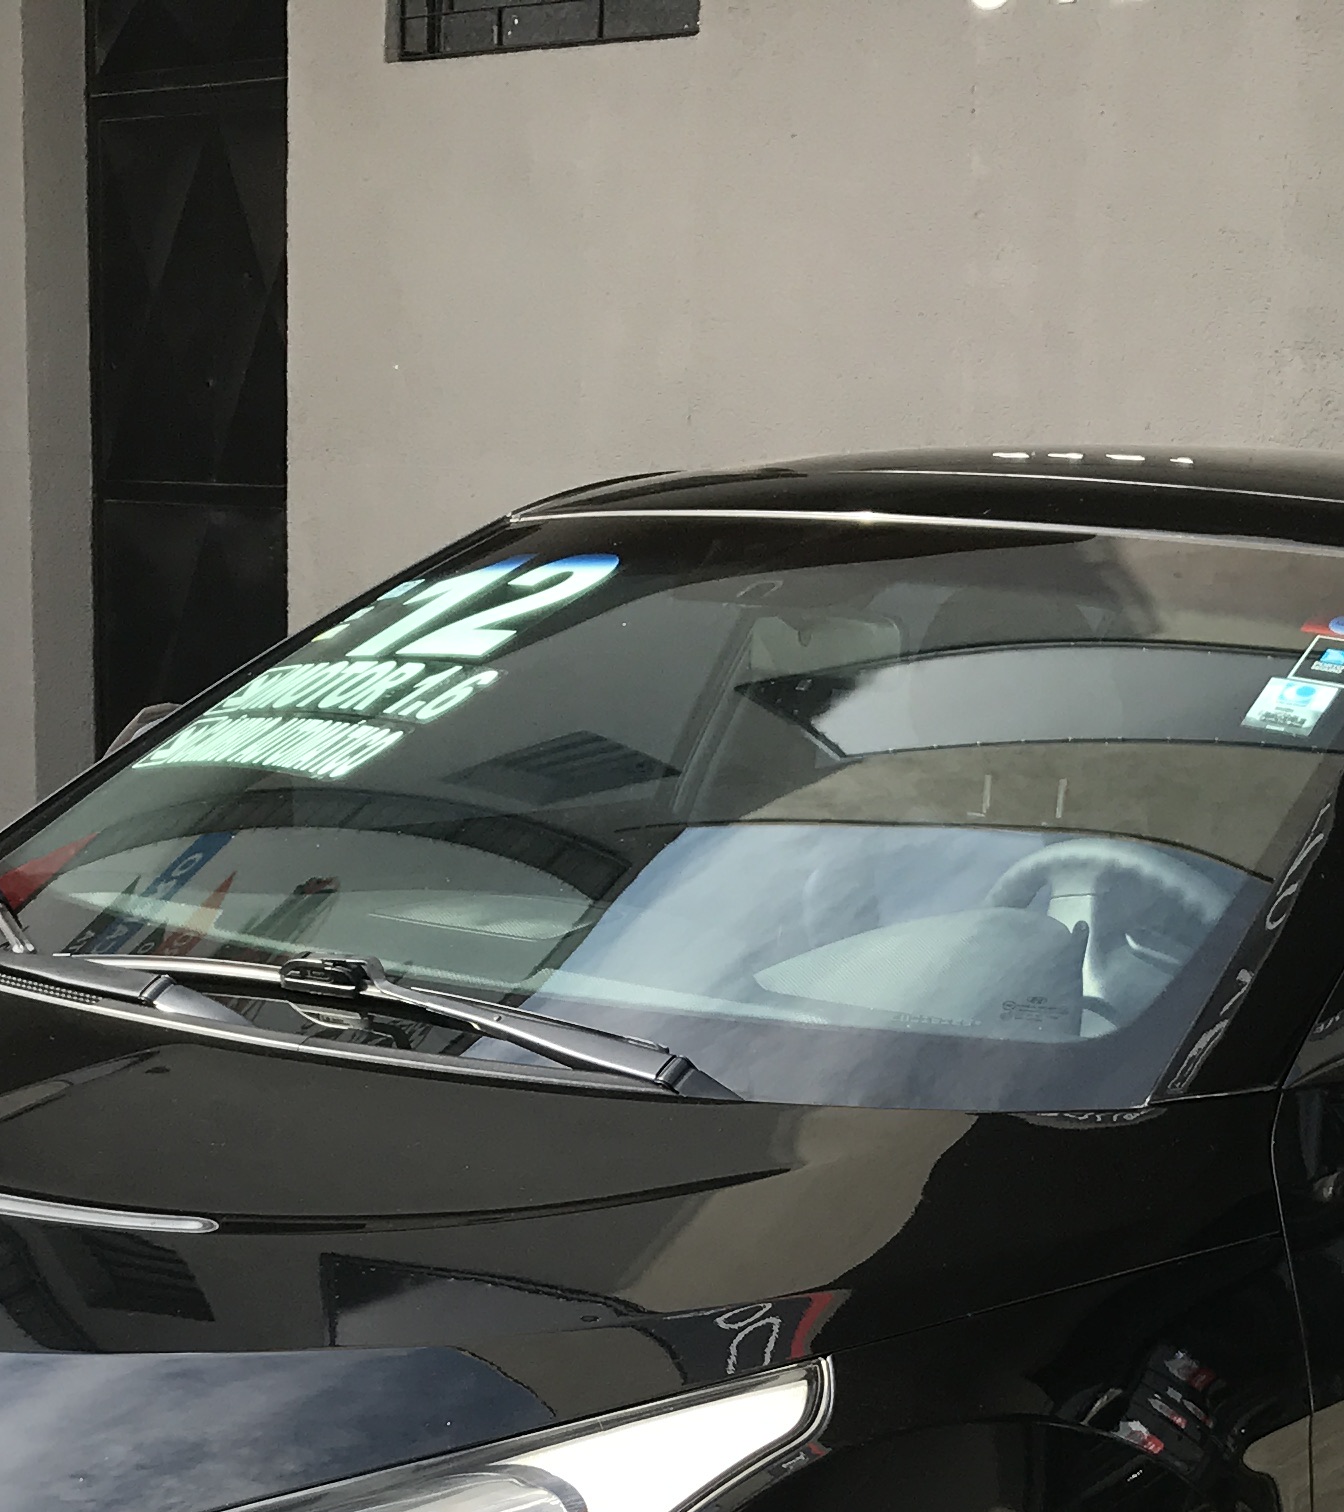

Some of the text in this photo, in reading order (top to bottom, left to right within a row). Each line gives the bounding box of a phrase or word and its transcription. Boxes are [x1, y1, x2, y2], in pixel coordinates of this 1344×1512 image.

[346, 554, 620, 657] 12
[238, 660, 499, 720] MOTOR 1.6
